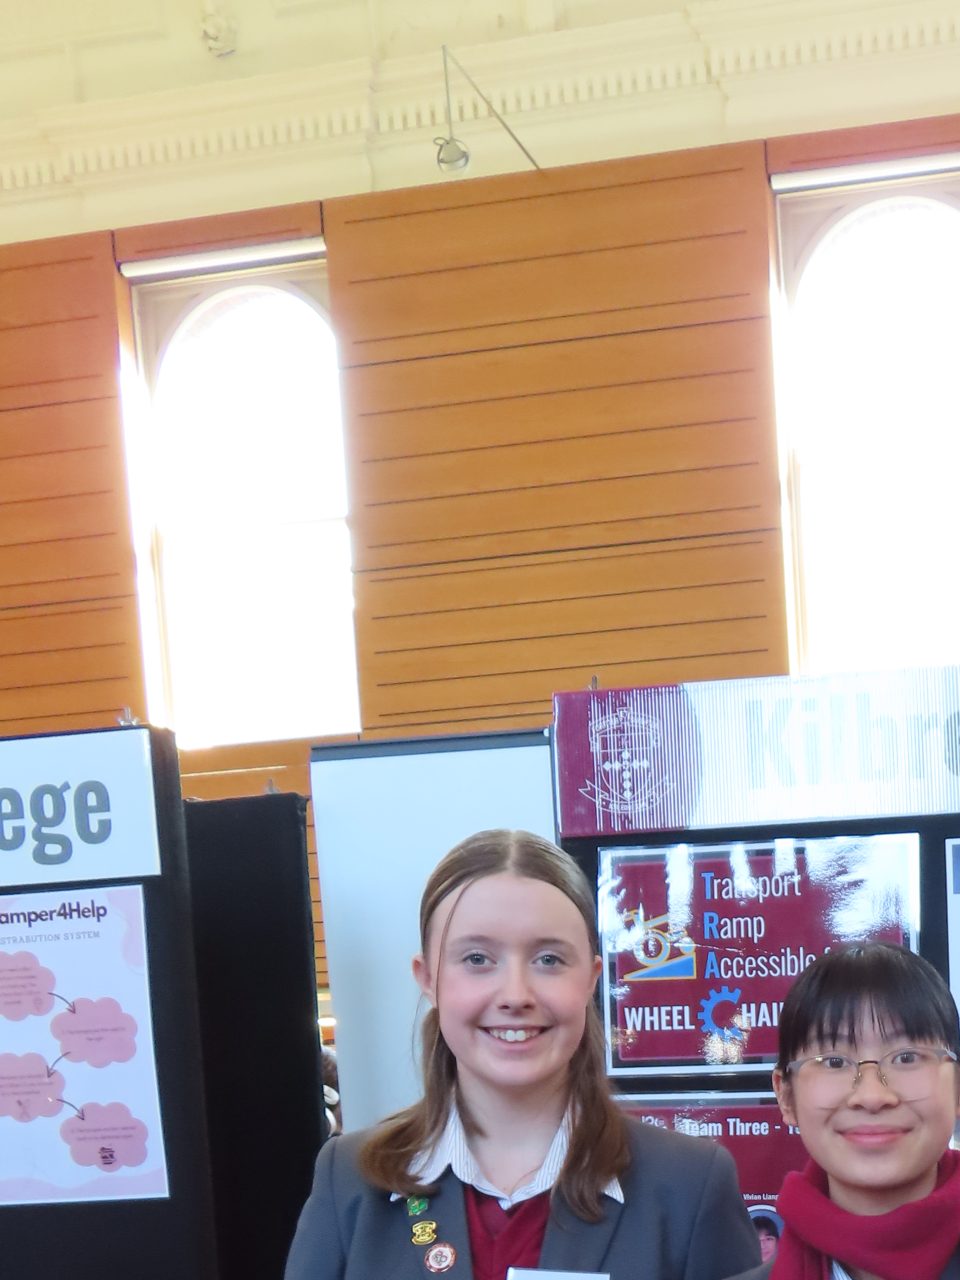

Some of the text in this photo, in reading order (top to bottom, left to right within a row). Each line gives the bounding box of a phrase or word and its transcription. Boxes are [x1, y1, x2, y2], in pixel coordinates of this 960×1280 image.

[64, 930, 101, 942] SYSTEM
[704, 911, 765, 943] Ramp
[740, 1002, 784, 1028] HAI
[727, 1118, 769, 1136] Three
